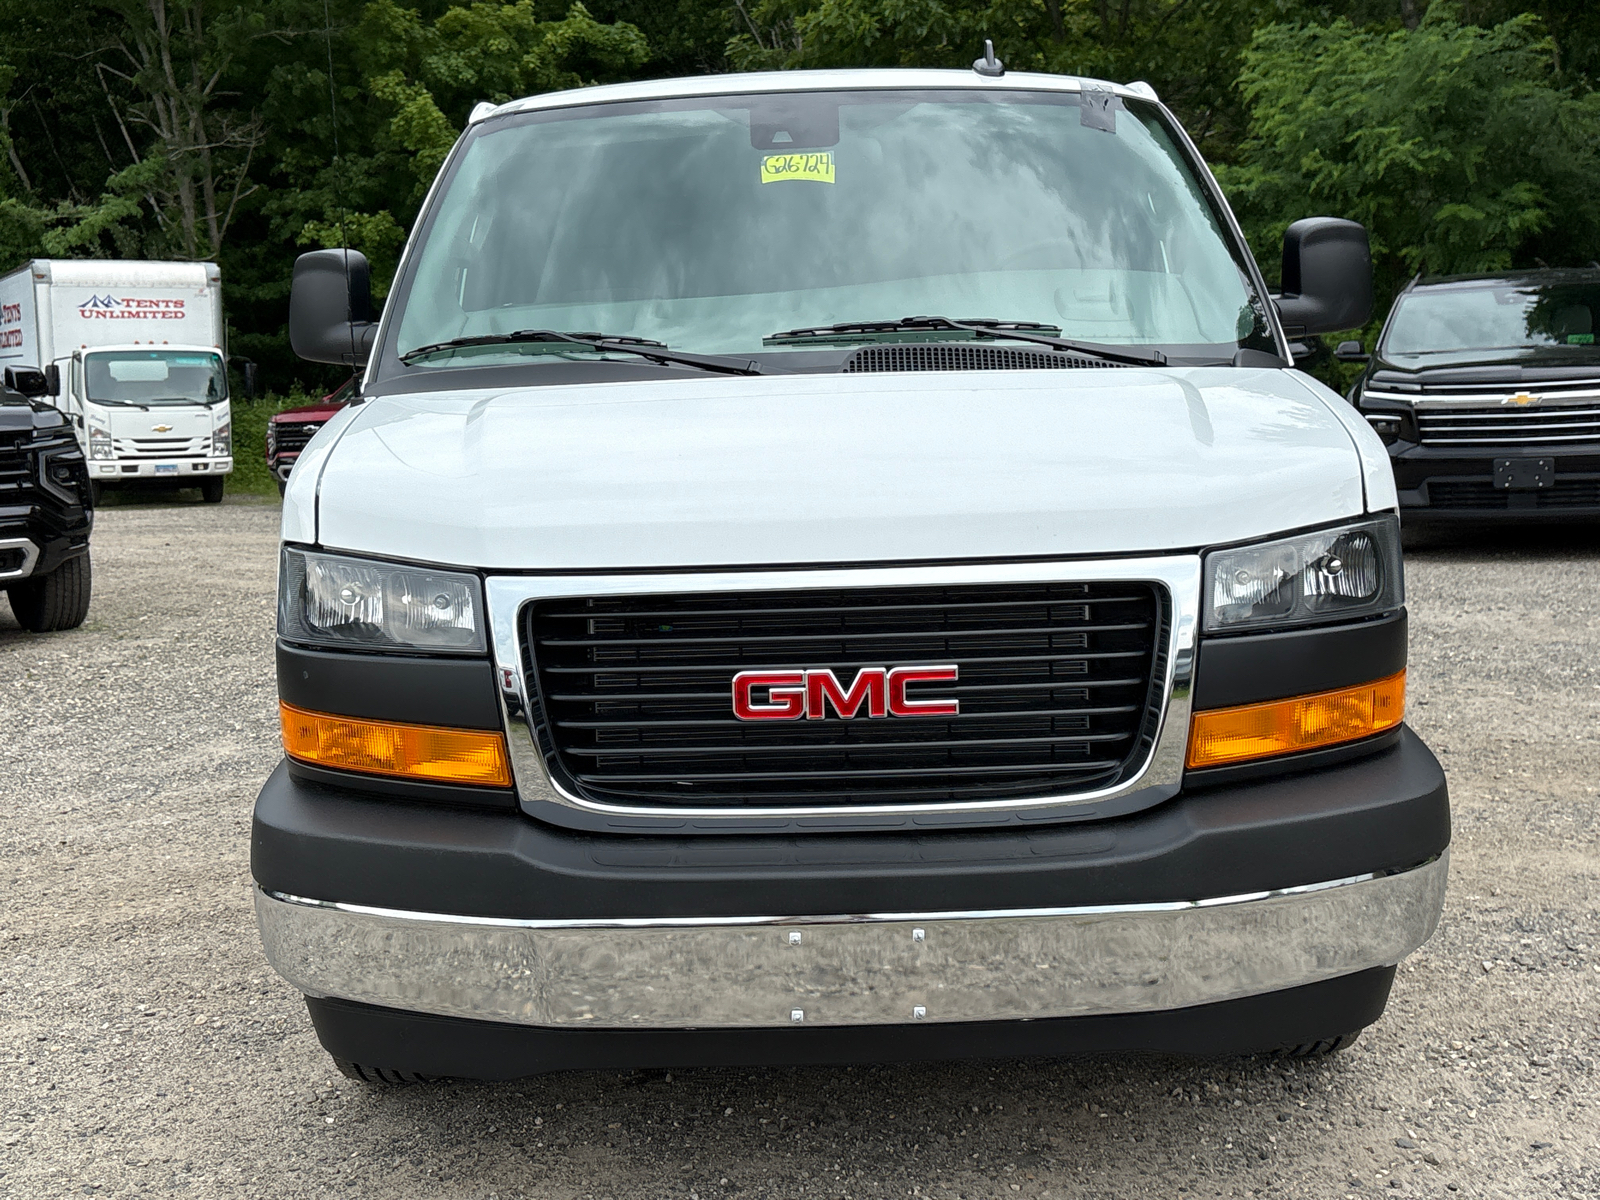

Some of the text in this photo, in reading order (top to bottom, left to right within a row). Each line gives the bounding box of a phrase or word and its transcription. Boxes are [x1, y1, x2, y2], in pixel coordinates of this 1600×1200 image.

[121, 298, 185, 308] TENTS
[80, 309, 185, 319] UNLIMITED
[732, 664, 960, 721] GMC
